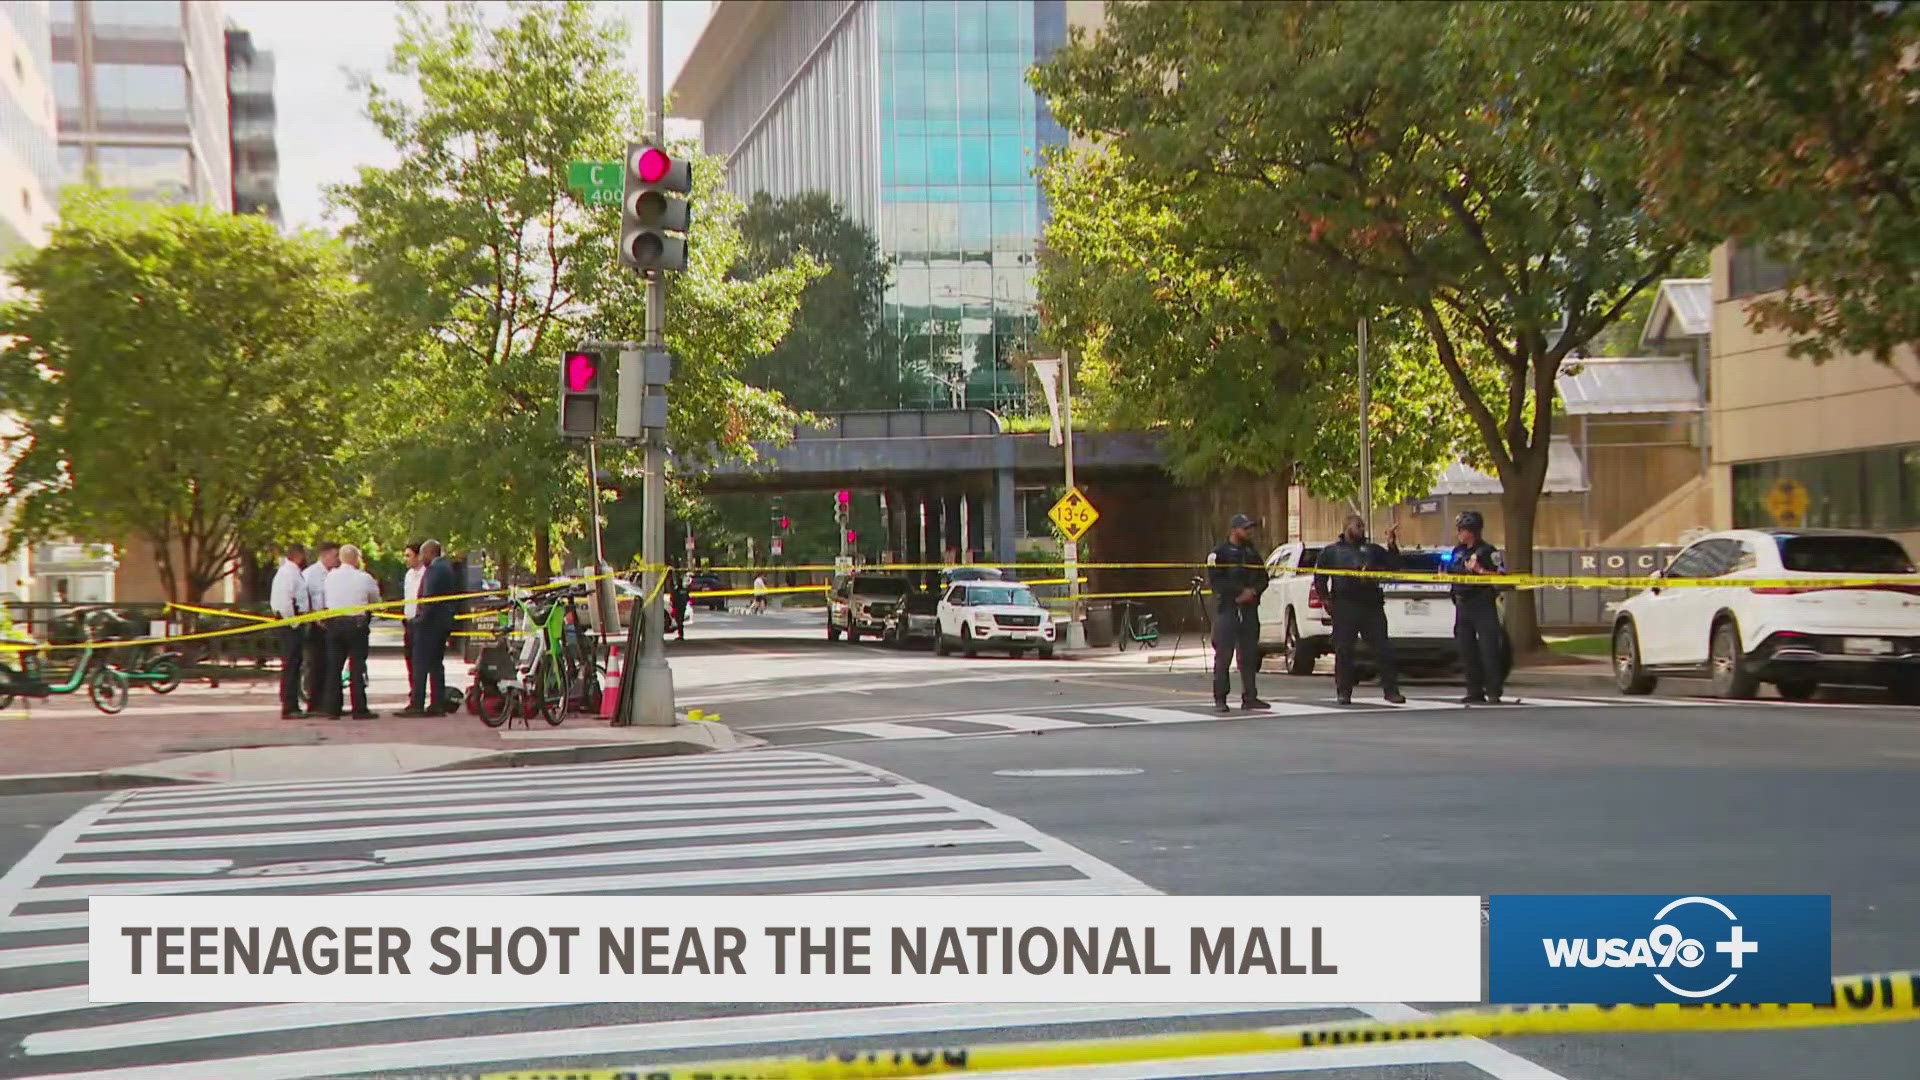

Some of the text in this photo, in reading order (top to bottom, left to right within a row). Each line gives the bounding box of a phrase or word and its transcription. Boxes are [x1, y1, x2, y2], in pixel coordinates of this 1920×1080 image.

[590, 166, 603, 185] C
[591, 189, 623, 202] 400
[1057, 507, 1089, 522] 13-6
